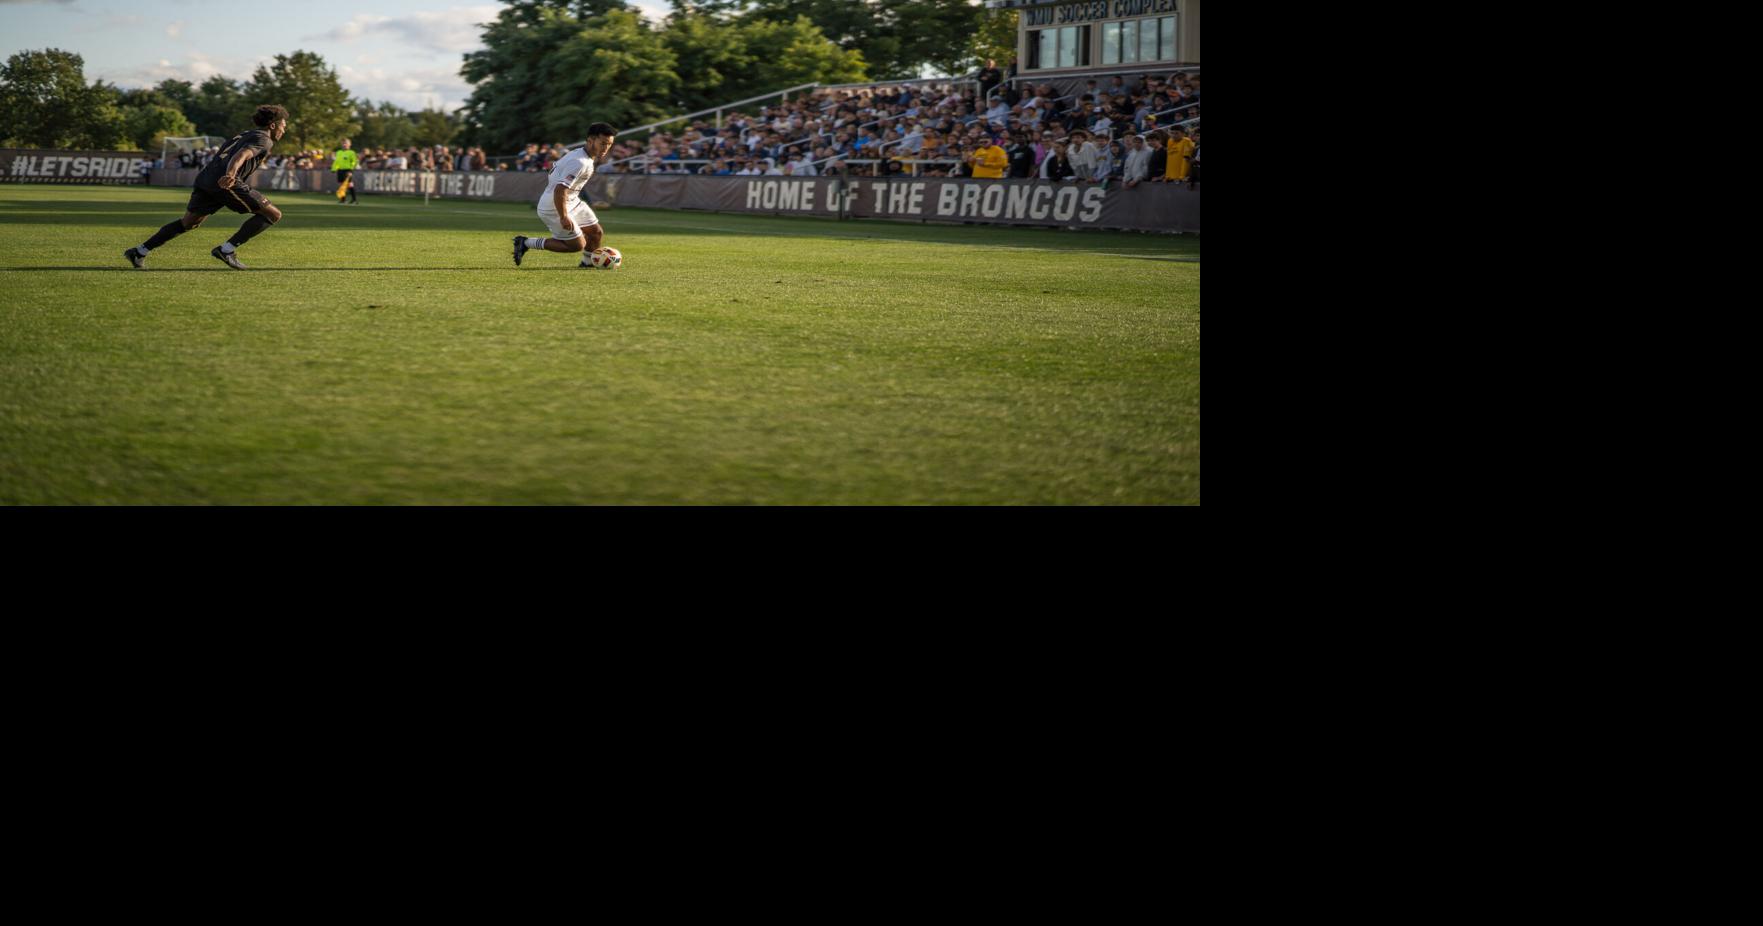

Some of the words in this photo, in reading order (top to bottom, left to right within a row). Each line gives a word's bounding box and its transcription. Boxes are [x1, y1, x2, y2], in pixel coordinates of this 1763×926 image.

[1026, 6, 1054, 26] WMU
[1058, 2, 1109, 23] SOCCER
[1113, 0, 1177, 18] COMPLEX
[11, 155, 144, 178] #LETSRIDE
[363, 171, 416, 192] WELCOME
[420, 172, 436, 193] TO
[440, 174, 463, 195] THE
[467, 174, 495, 197] ZOO
[746, 181, 816, 211] HOME
[872, 182, 926, 214] THE
[937, 183, 1106, 222] BRONCOS
